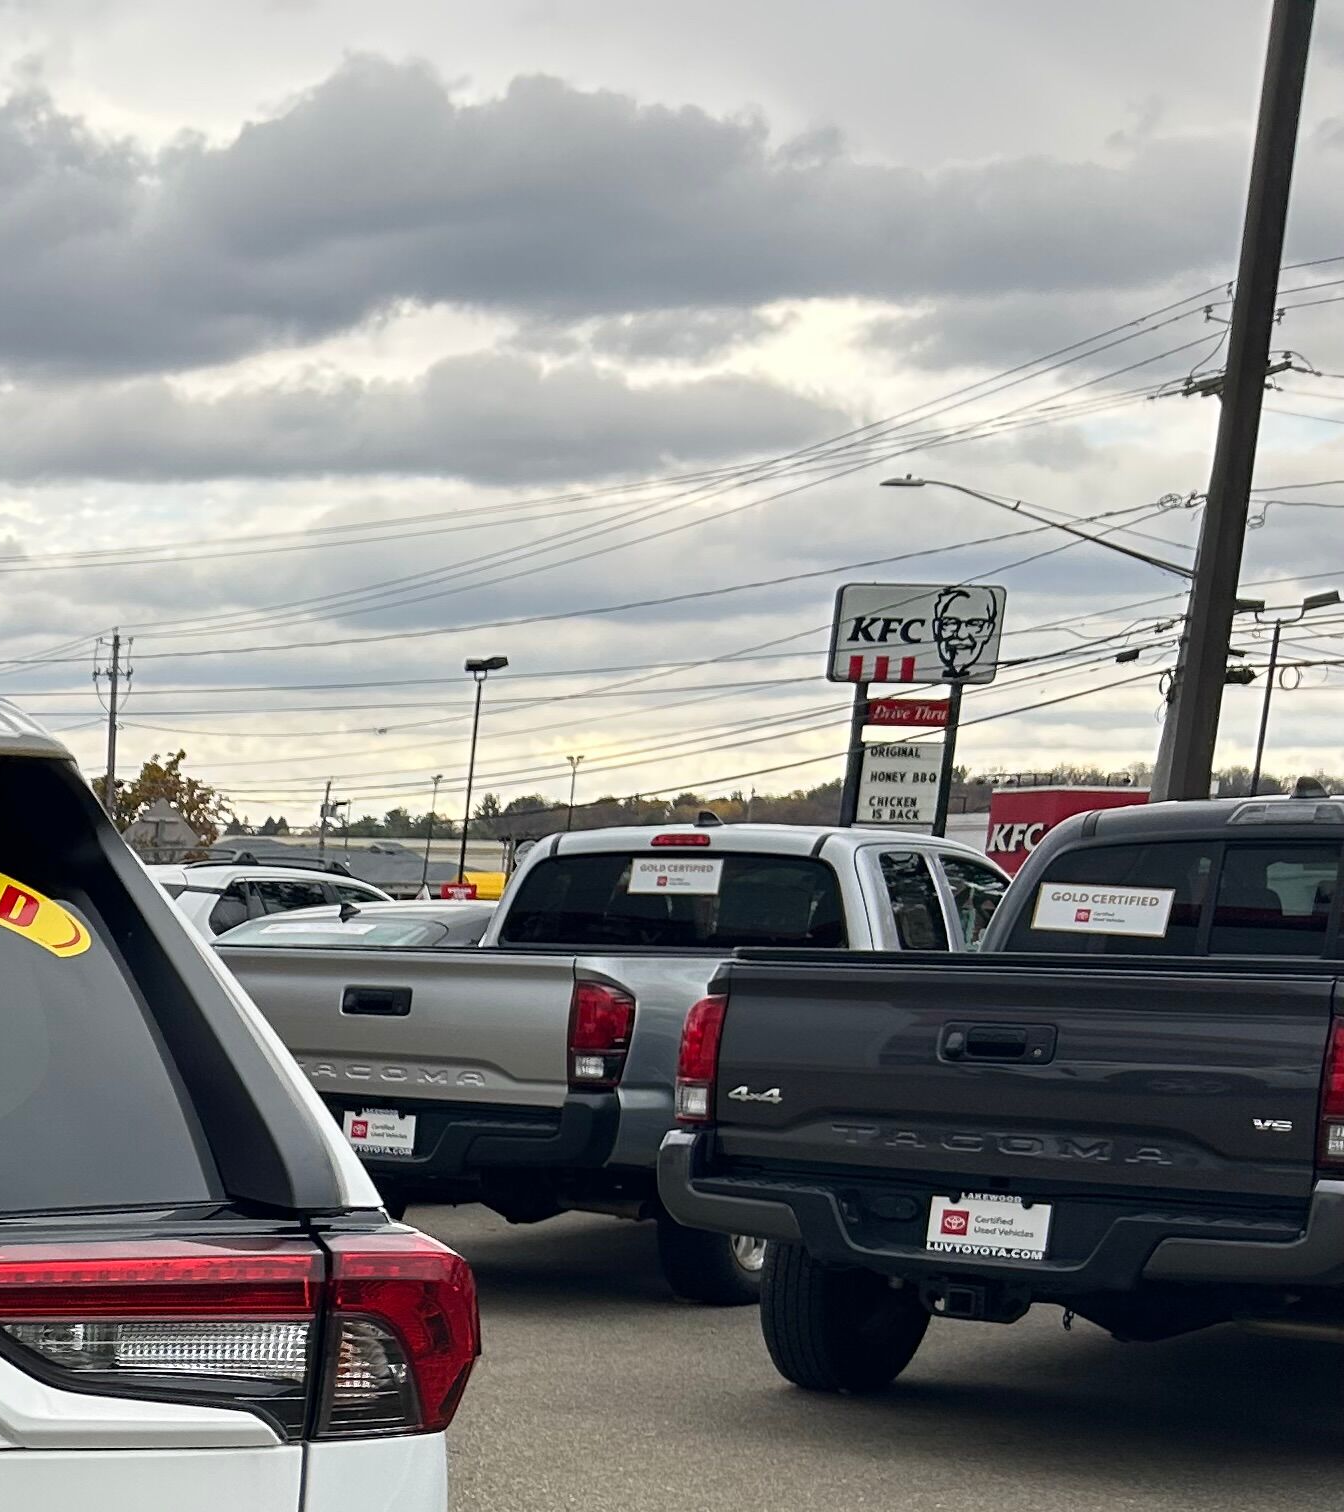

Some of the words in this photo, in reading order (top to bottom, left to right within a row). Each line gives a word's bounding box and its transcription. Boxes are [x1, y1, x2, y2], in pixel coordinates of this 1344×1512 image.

[847, 616, 925, 643] KFC
[873, 705, 911, 720] Drive
[914, 705, 947, 721] Thru
[870, 746, 921, 758] ORIGINAL
[870, 771, 907, 783] HONEY
[869, 796, 918, 808] CHICKEN
[872, 808, 882, 819] IS
[889, 809, 920, 820] BACK
[987, 822, 1044, 852] KFC
[640, 864, 666, 873] GOLD
[667, 864, 714, 873] CERTIFIED
[1051, 892, 1090, 903] GOLD
[1091, 894, 1160, 907] CERTIFIED
[298, 1062, 486, 1087] ACOMA
[727, 1084, 783, 1103] 4x4
[1252, 1118, 1293, 1132] V6
[352, 1144, 412, 1156] VTOYOTA.COM
[831, 1121, 1175, 1166] TACOMA
[961, 1191, 1022, 1203] LAKEWOOD
[974, 1215, 1014, 1226] Certified
[974, 1226, 997, 1235] Used
[998, 1228, 1034, 1238] Vehicles
[926, 1241, 1043, 1260] LUVTOYOTA.COM
